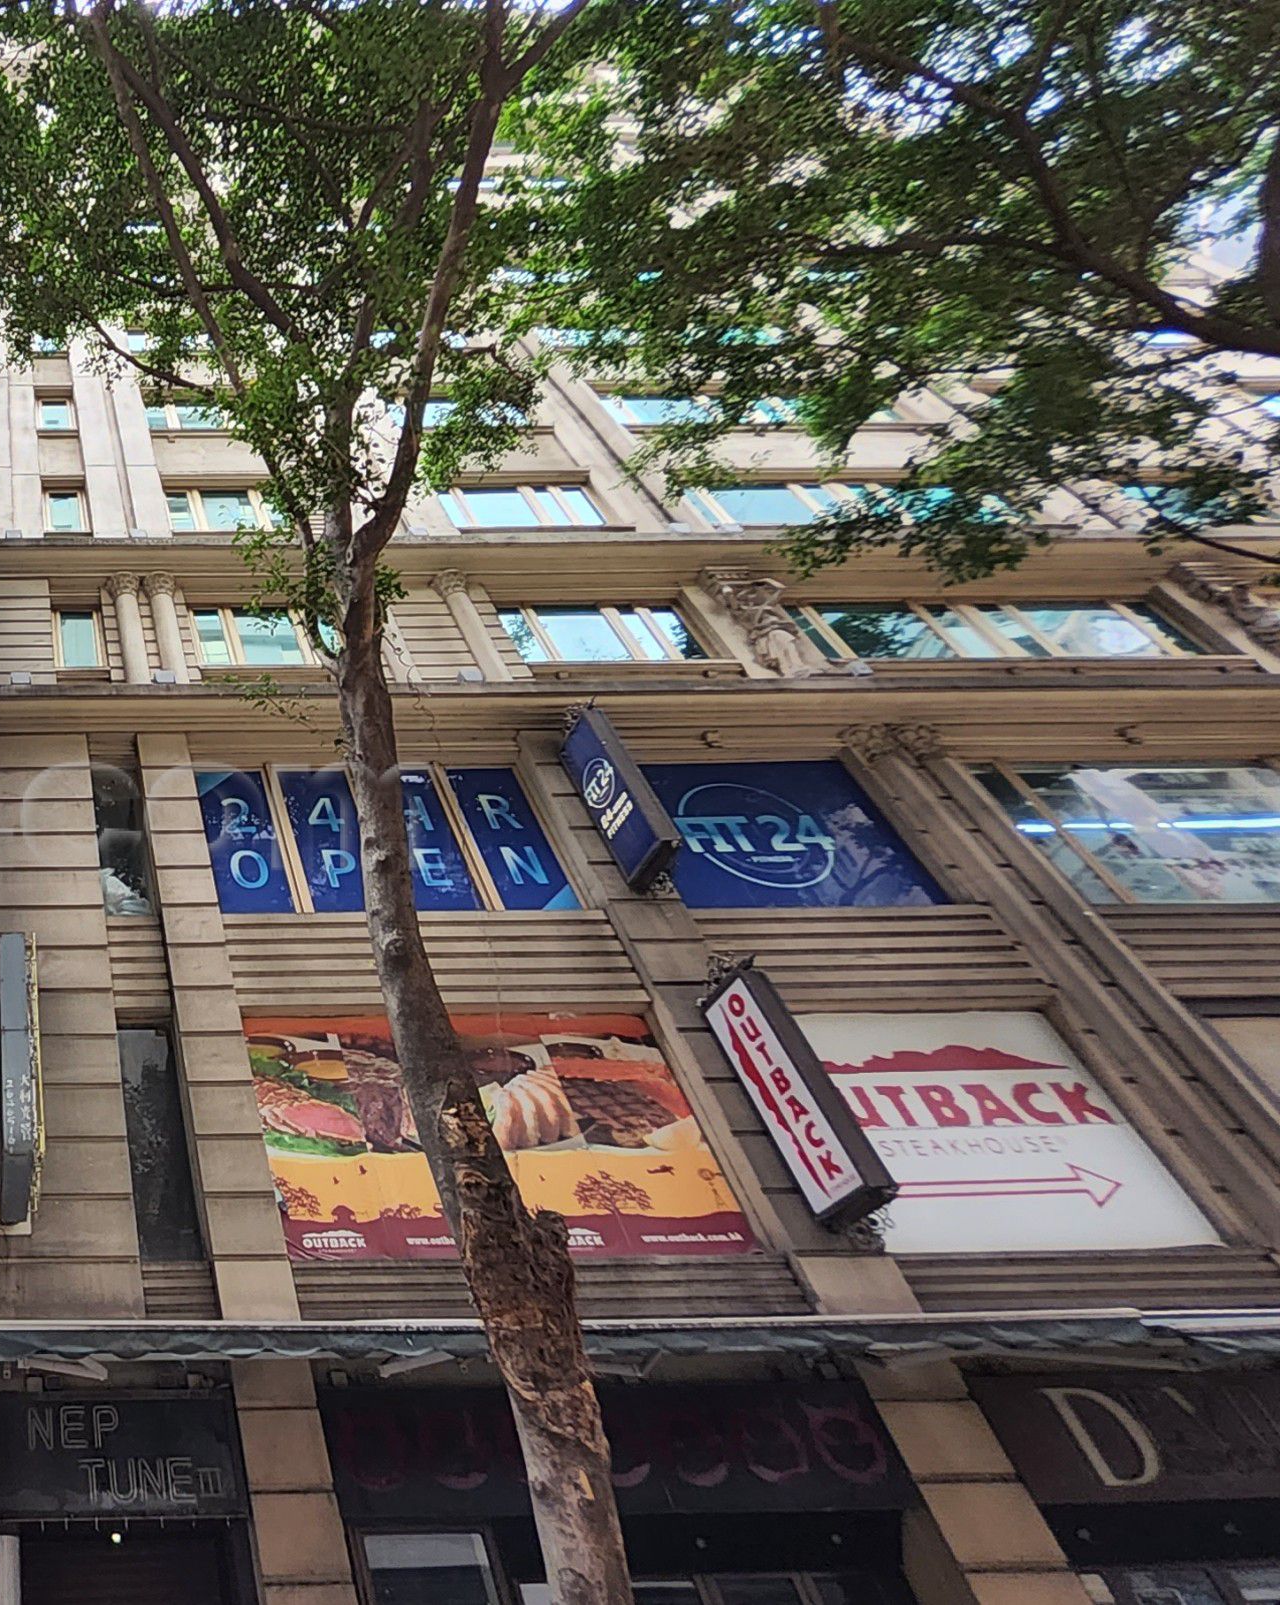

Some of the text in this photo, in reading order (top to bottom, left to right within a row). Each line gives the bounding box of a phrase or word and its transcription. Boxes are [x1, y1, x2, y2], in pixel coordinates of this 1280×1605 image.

[673, 814, 835, 852] FIT 24
[728, 992, 844, 1181] OUTBACK
[835, 1081, 1117, 1130] UTBACK
[879, 1135, 1062, 1158] STEAKHOUSE
[302, 1237, 367, 1249] OUTBACK
[27, 1405, 120, 1450] NEP
[78, 1456, 199, 1506] TUNE
